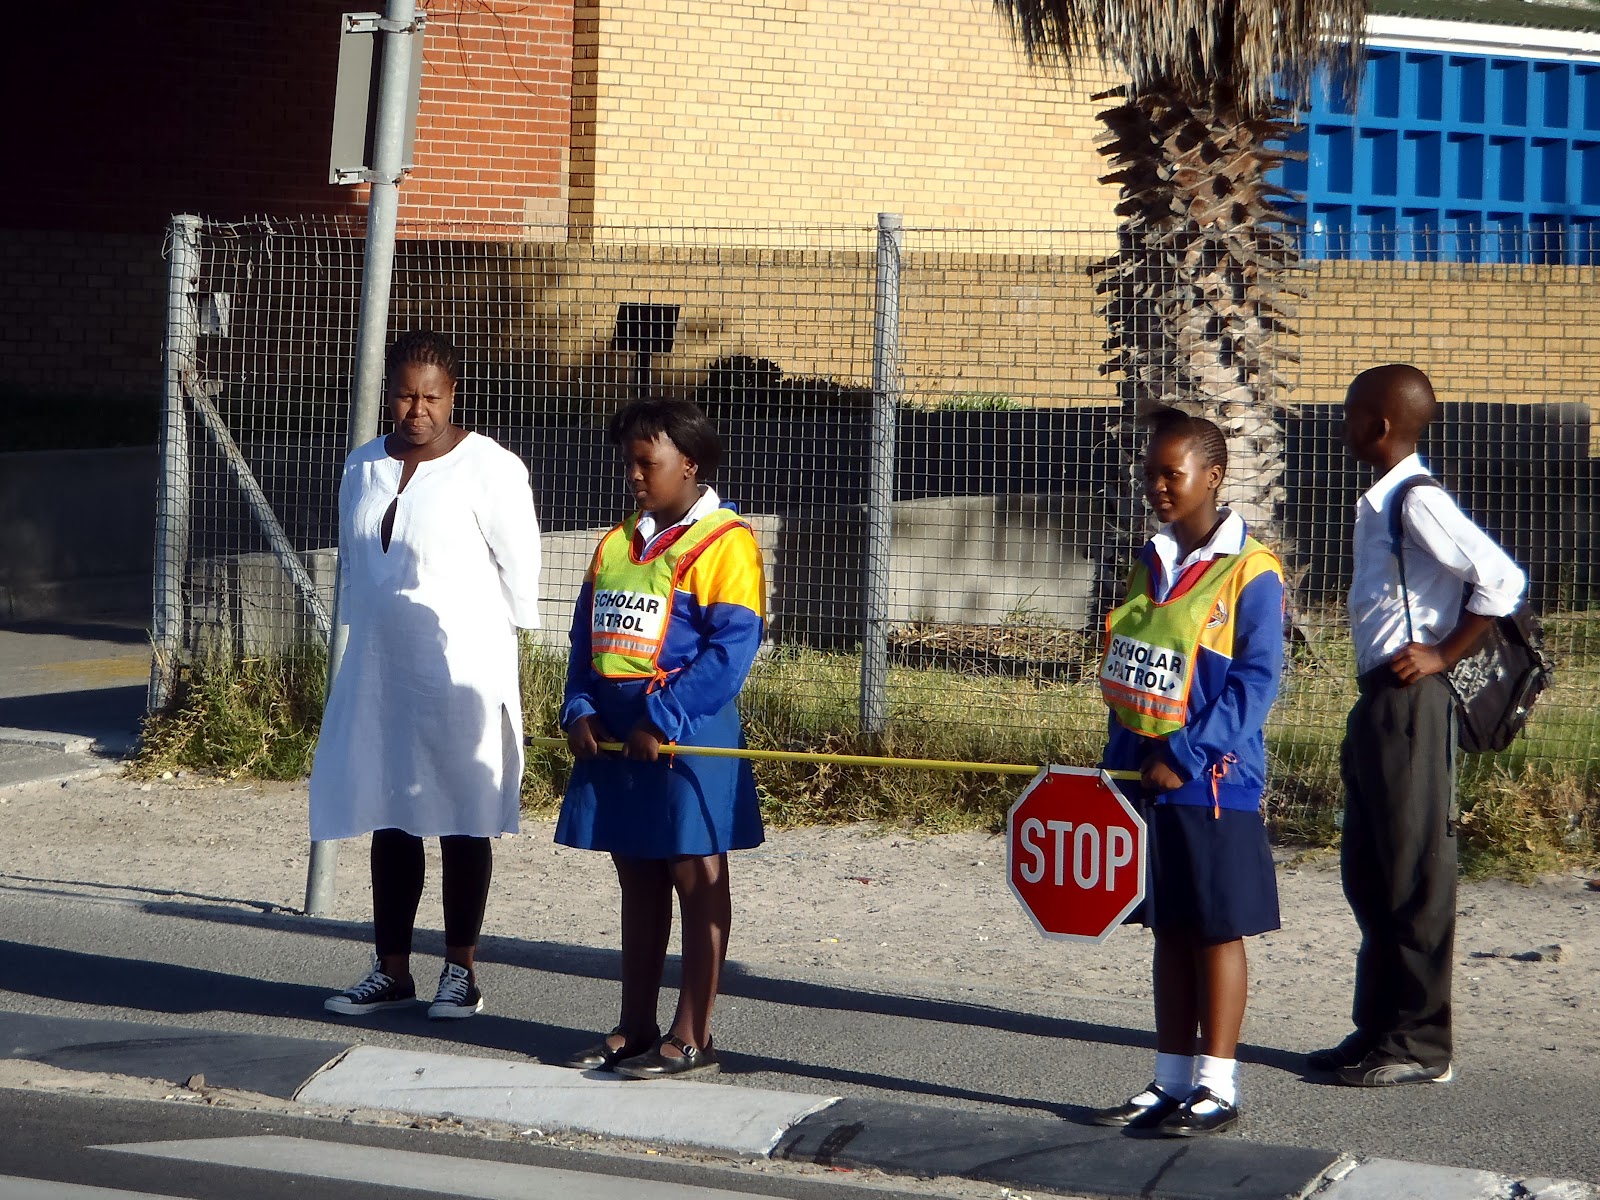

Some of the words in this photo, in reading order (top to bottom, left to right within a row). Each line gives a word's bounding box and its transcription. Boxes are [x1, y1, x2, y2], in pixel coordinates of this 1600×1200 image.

[594, 593, 660, 614] SCHOLAR
[594, 612, 644, 632] PATROL
[1112, 638, 1182, 674] SCHOLAR
[1112, 660, 1168, 692] PATROL
[1020, 817, 1133, 892] STOP
